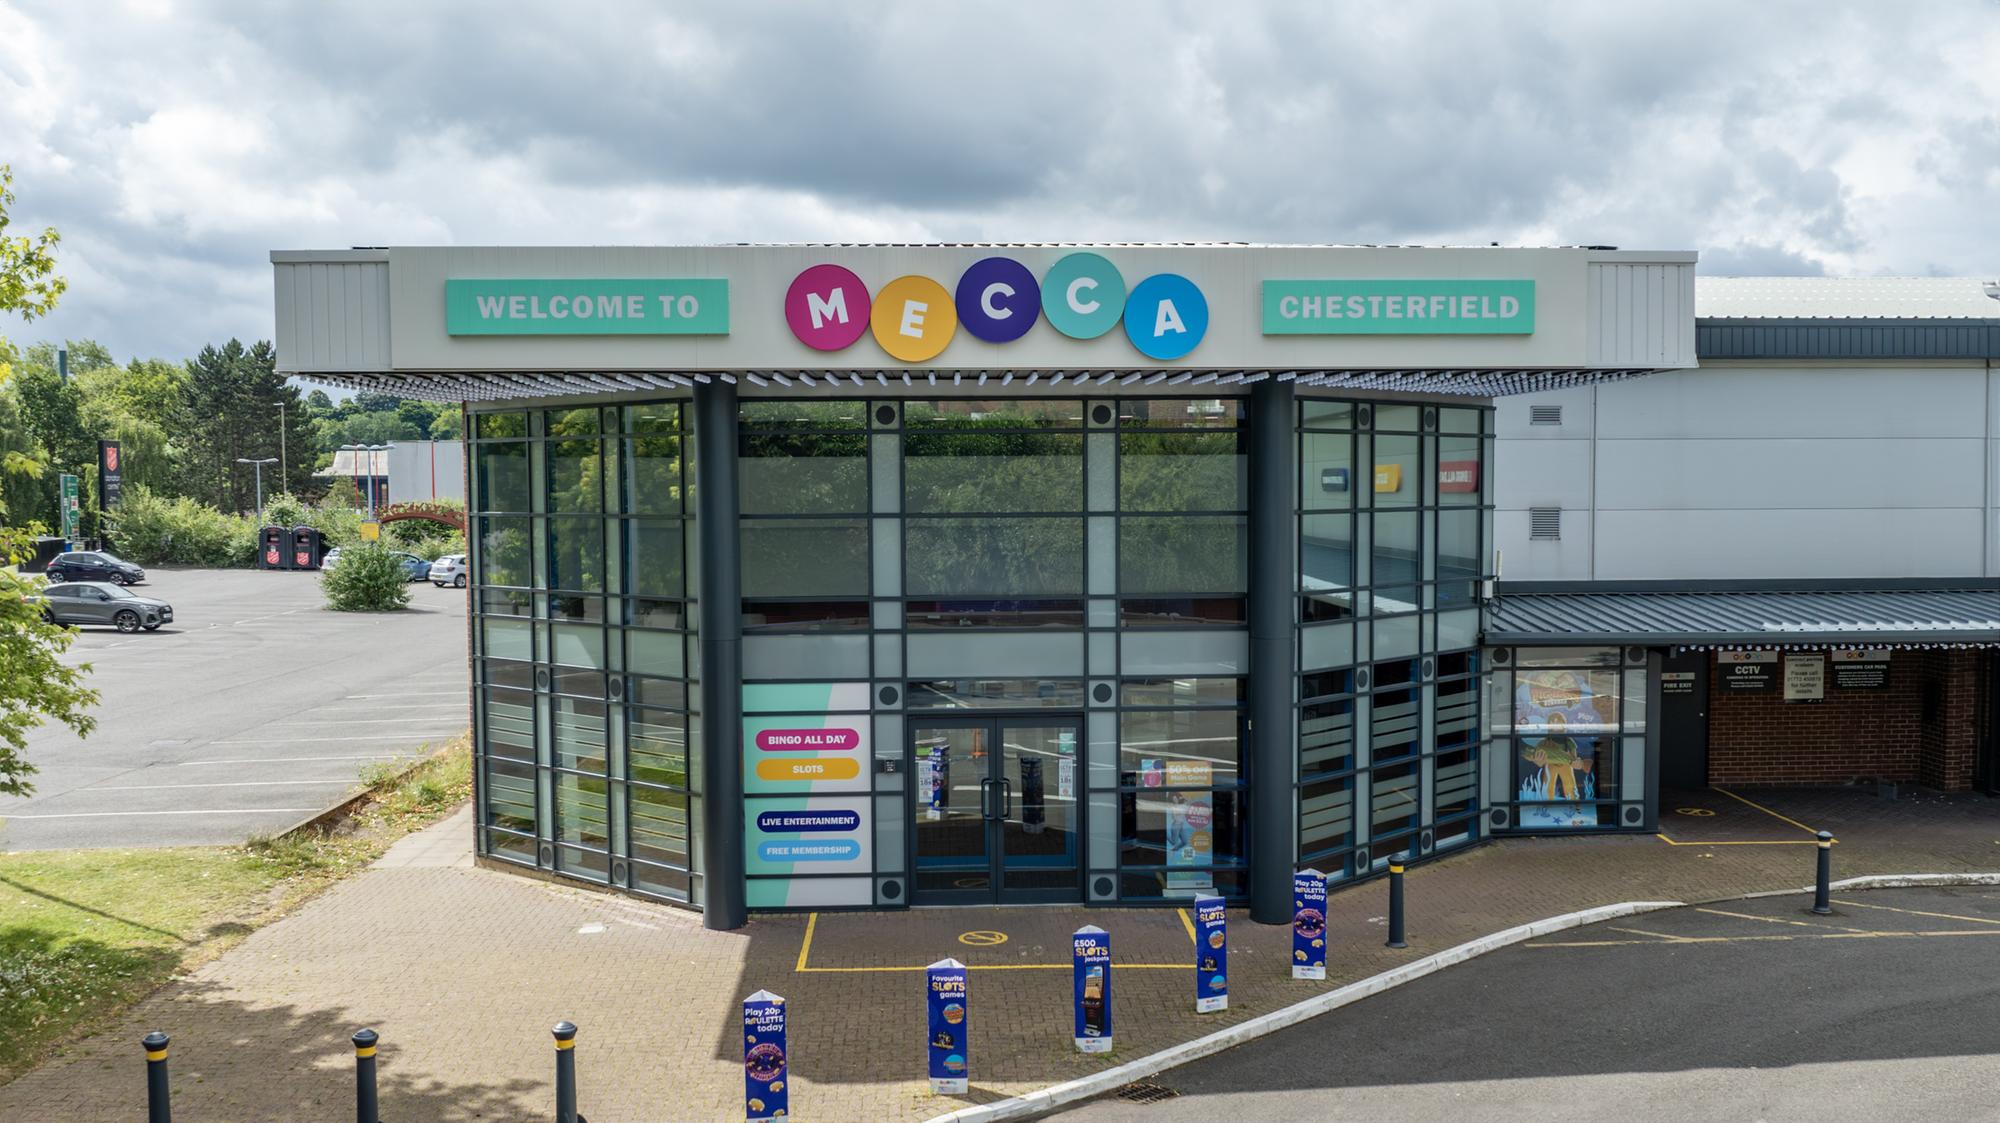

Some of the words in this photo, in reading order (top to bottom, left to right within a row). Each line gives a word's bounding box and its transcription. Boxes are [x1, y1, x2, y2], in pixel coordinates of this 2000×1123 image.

[476, 294, 645, 319] WELCOME
[658, 294, 699, 319] TO
[806, 276, 1187, 339] MECCA
[1279, 295, 1520, 319] CHESTERFIELD
[1735, 666, 1761, 674] CCTV
[768, 735, 801, 745] BINGO
[804, 735, 824, 745] ALL
[825, 734, 847, 744] DAY
[791, 764, 824, 774] SLOTS
[761, 817, 782, 826] LIVE
[783, 816, 855, 826] ENTERTAINMENT
[766, 846, 789, 855] FREE
[791, 845, 852, 855] MEMBERSHIP
[1295, 879, 1310, 887] Play
[1310, 880, 1324, 888] 20p
[1304, 893, 1325, 901] today
[1199, 905, 1224, 914] Favourite
[1199, 911, 1225, 922] SLOTS
[1206, 920, 1225, 929] games
[1074, 939, 1096, 948] £500
[1075, 947, 1109, 957] SLOTS
[1084, 955, 1110, 963] jackpots
[932, 982, 966, 992] SLOTS
[939, 991, 965, 999] games
[744, 1008, 764, 1018] Play
[764, 1007, 781, 1017] 20p
[757, 1024, 784, 1033] today
